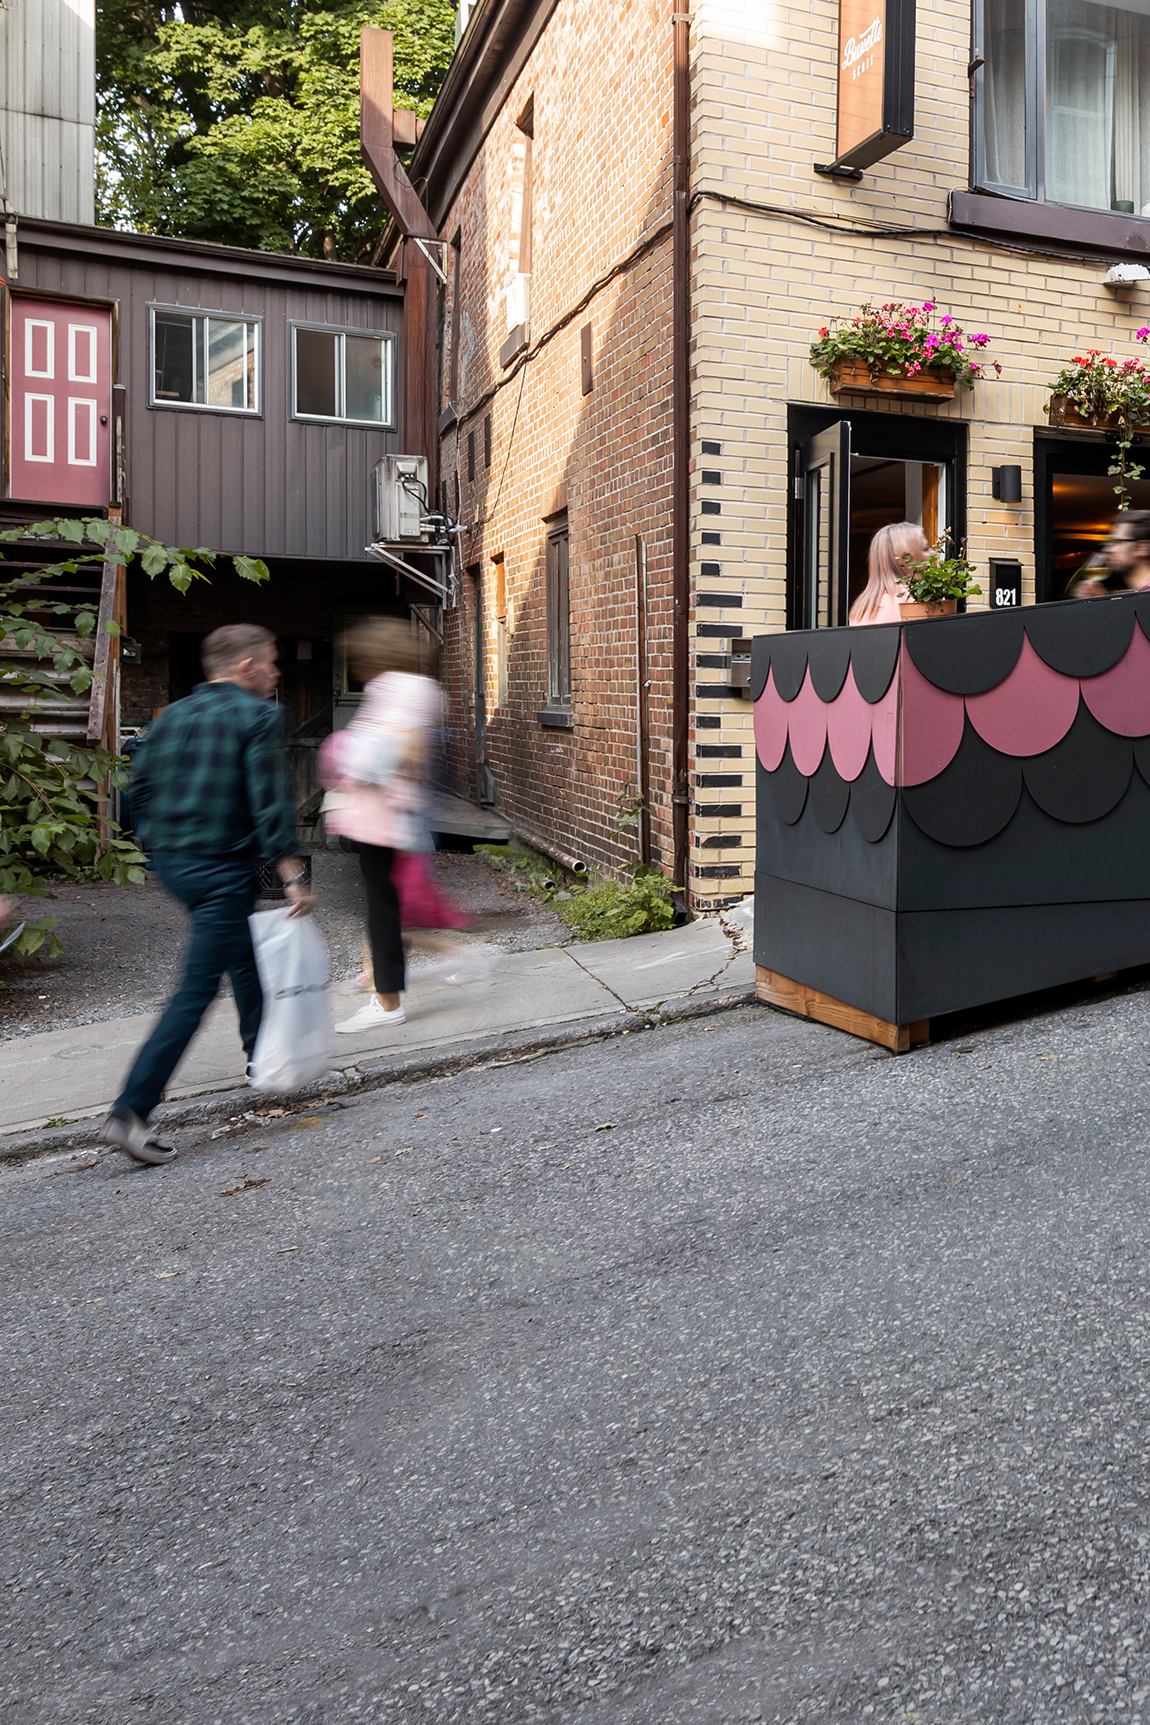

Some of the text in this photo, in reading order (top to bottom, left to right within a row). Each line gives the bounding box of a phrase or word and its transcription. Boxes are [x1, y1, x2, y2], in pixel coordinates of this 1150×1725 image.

[842, 16, 882, 71] Buvette
[852, 54, 873, 80] SCOTT
[996, 588, 1016, 605] 821
